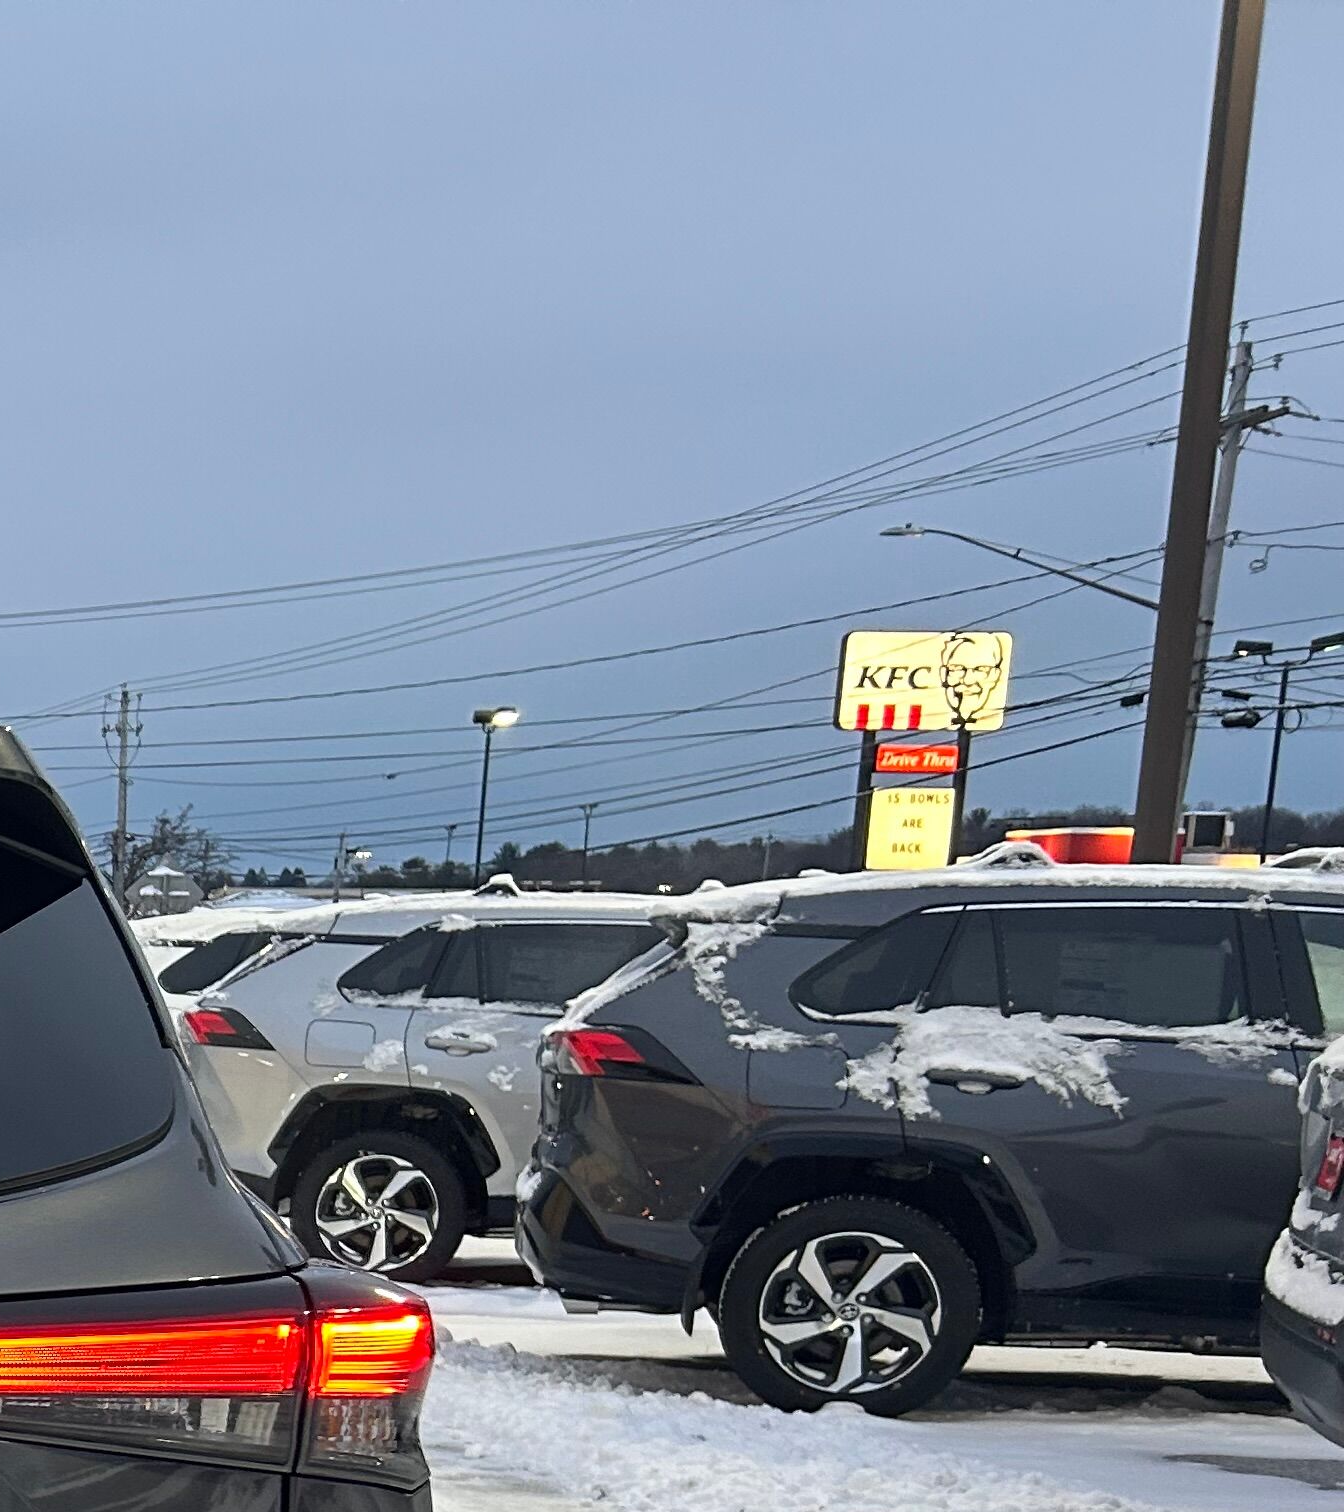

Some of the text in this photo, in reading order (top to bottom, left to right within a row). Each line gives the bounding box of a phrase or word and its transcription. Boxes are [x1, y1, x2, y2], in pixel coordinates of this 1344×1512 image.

[856, 666, 931, 689] KFC
[880, 751, 956, 767] Drive Thru
[910, 793, 950, 804] BOWLS
[902, 818, 923, 828] ARE
[892, 842, 921, 853] BACK
